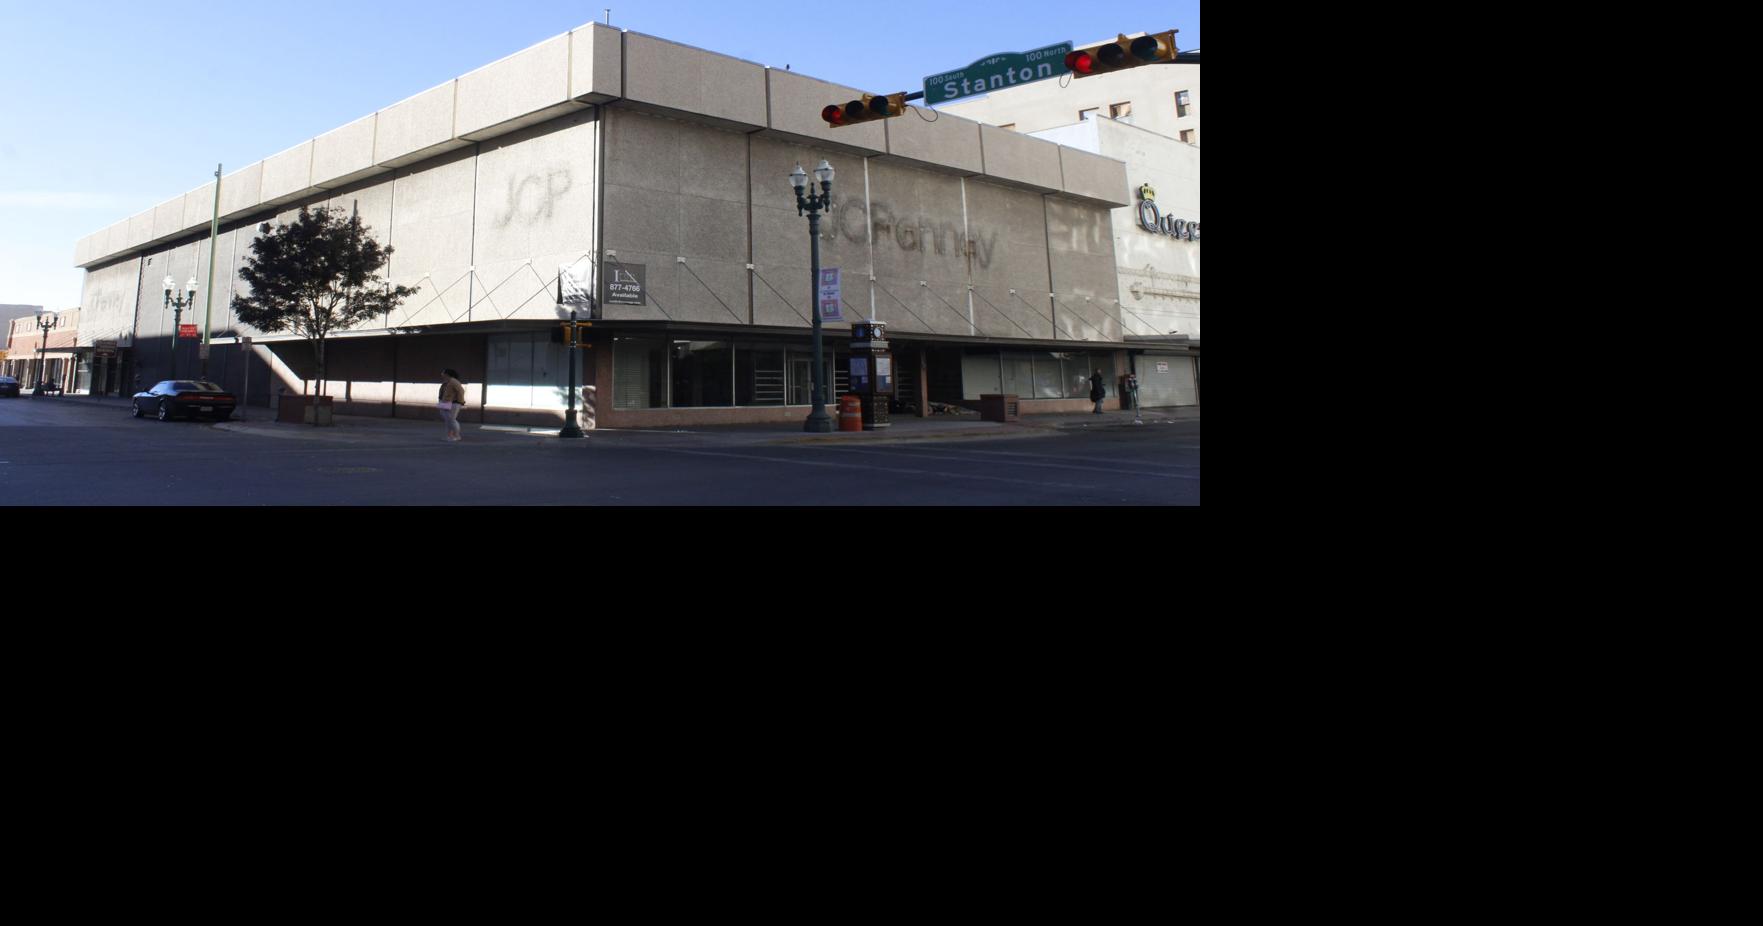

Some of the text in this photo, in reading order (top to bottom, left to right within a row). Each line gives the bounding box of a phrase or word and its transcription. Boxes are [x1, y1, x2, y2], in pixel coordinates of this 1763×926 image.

[1026, 47, 1067, 62] 100 North
[928, 76, 944, 86] 100
[943, 63, 1052, 98] Stanton
[1138, 199, 1200, 241] Quee
